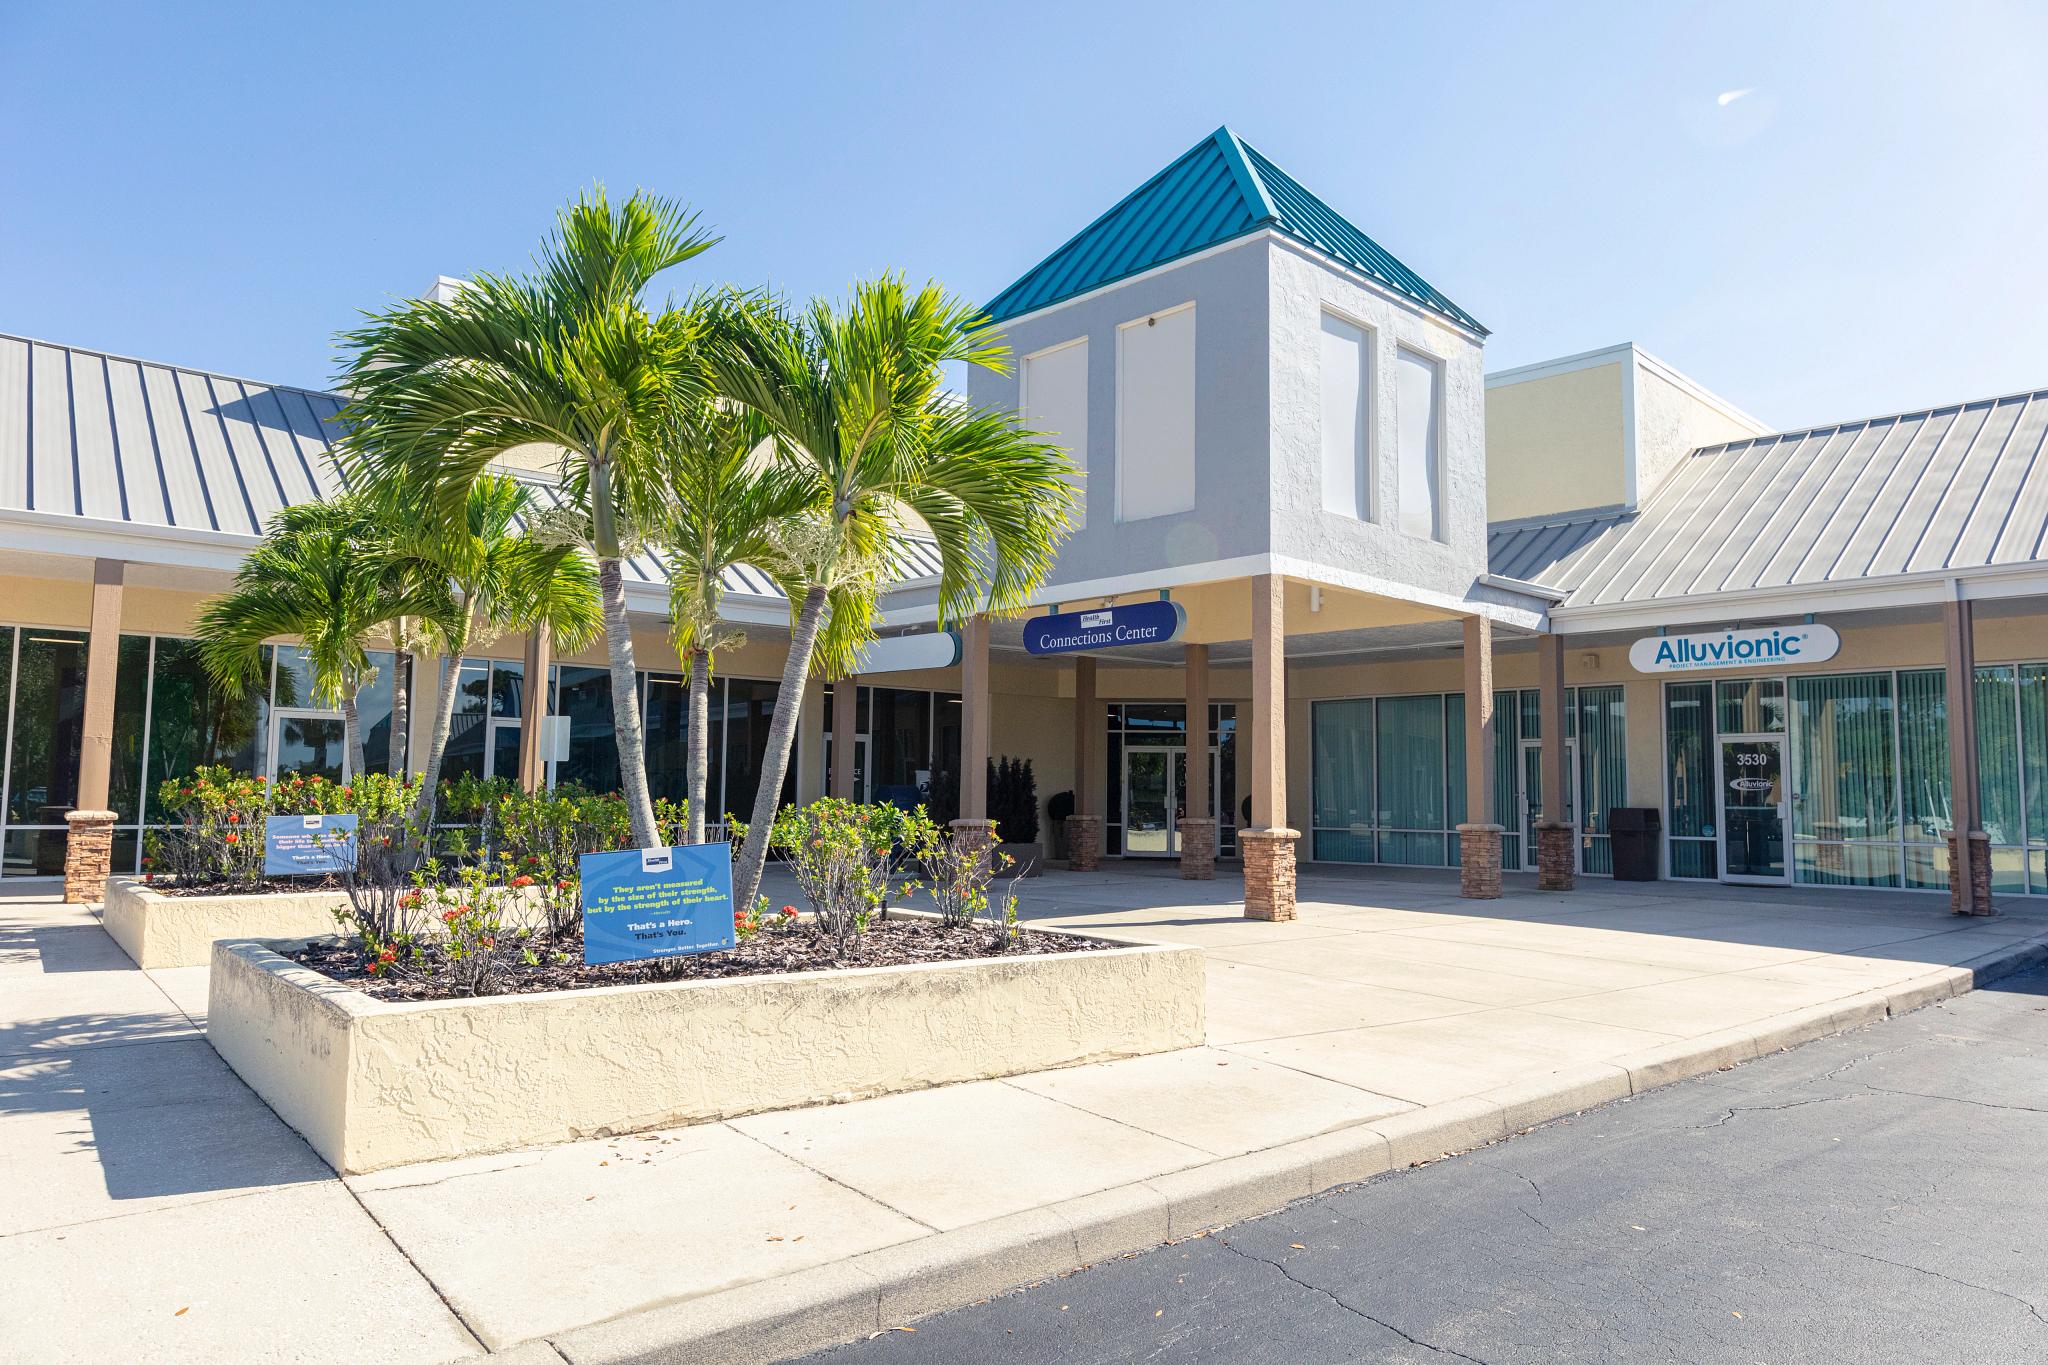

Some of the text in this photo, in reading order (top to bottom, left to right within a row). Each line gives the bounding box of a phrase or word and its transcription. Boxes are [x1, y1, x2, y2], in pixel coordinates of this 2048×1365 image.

[1040, 625, 1158, 649] Connections Center
[1744, 656, 1786, 664] ENGINEERING
[1737, 753, 1767, 766] 3530
[613, 878, 703, 894] They aren't measured
[598, 896, 609, 904] by
[628, 893, 645, 901] size
[658, 890, 678, 898] their
[680, 886, 717, 896] strength,
[587, 906, 602, 914] but
[604, 905, 615, 913] by
[617, 903, 631, 911] the
[633, 900, 669, 909] strength
[705, 893, 729, 902] heart.
[627, 922, 656, 931] That's
[667, 918, 693, 927] Hero.
[635, 929, 687, 940] That's You.
